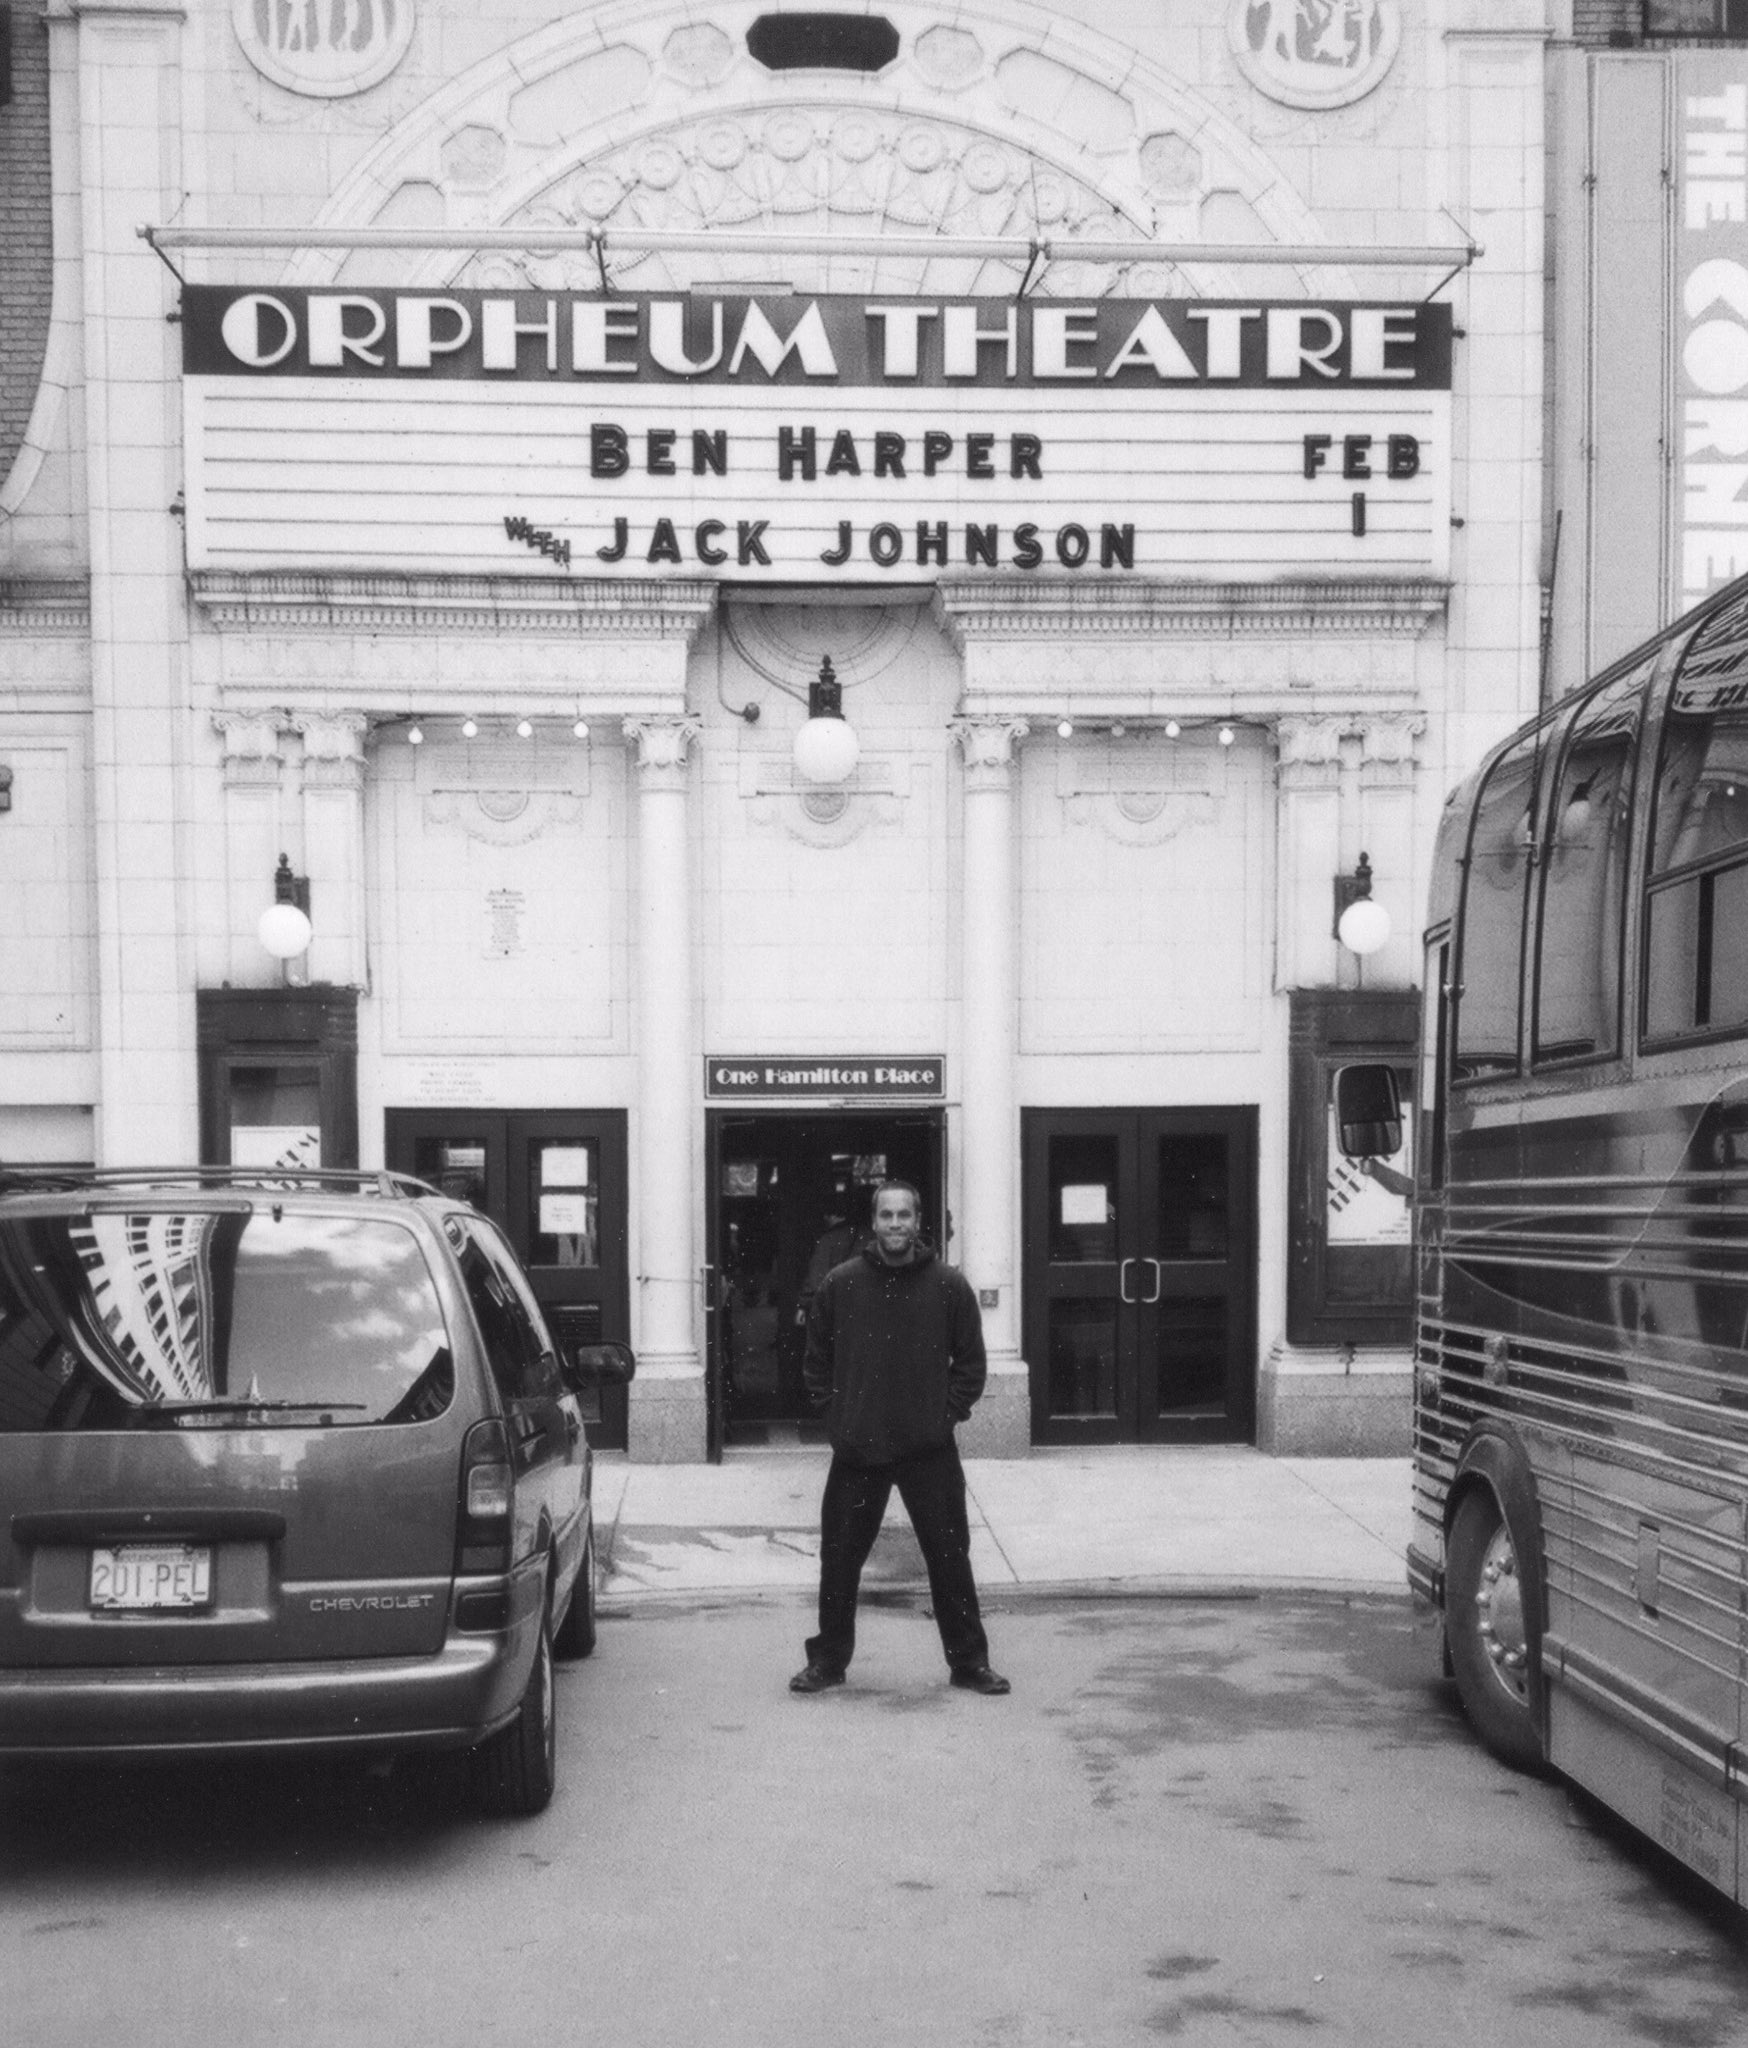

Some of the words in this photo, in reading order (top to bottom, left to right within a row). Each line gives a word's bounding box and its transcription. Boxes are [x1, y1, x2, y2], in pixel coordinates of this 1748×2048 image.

[1685, 84, 1747, 229] THE
[220, 293, 839, 379] ORPHEUM
[864, 303, 1416, 379] THEATRE
[589, 423, 729, 480] BEN
[777, 426, 1043, 481] HARPER
[1302, 434, 1420, 480] FEB
[1683, 259, 1748, 618] CORNE
[503, 516, 571, 564] WITH
[596, 517, 772, 567] JACK
[820, 520, 1136, 570] JOHNSON
[715, 1067, 759, 1084] One
[765, 1067, 868, 1084] Hamilton
[874, 1067, 935, 1084] Place
[309, 1594, 434, 1611] CHEVROLET
